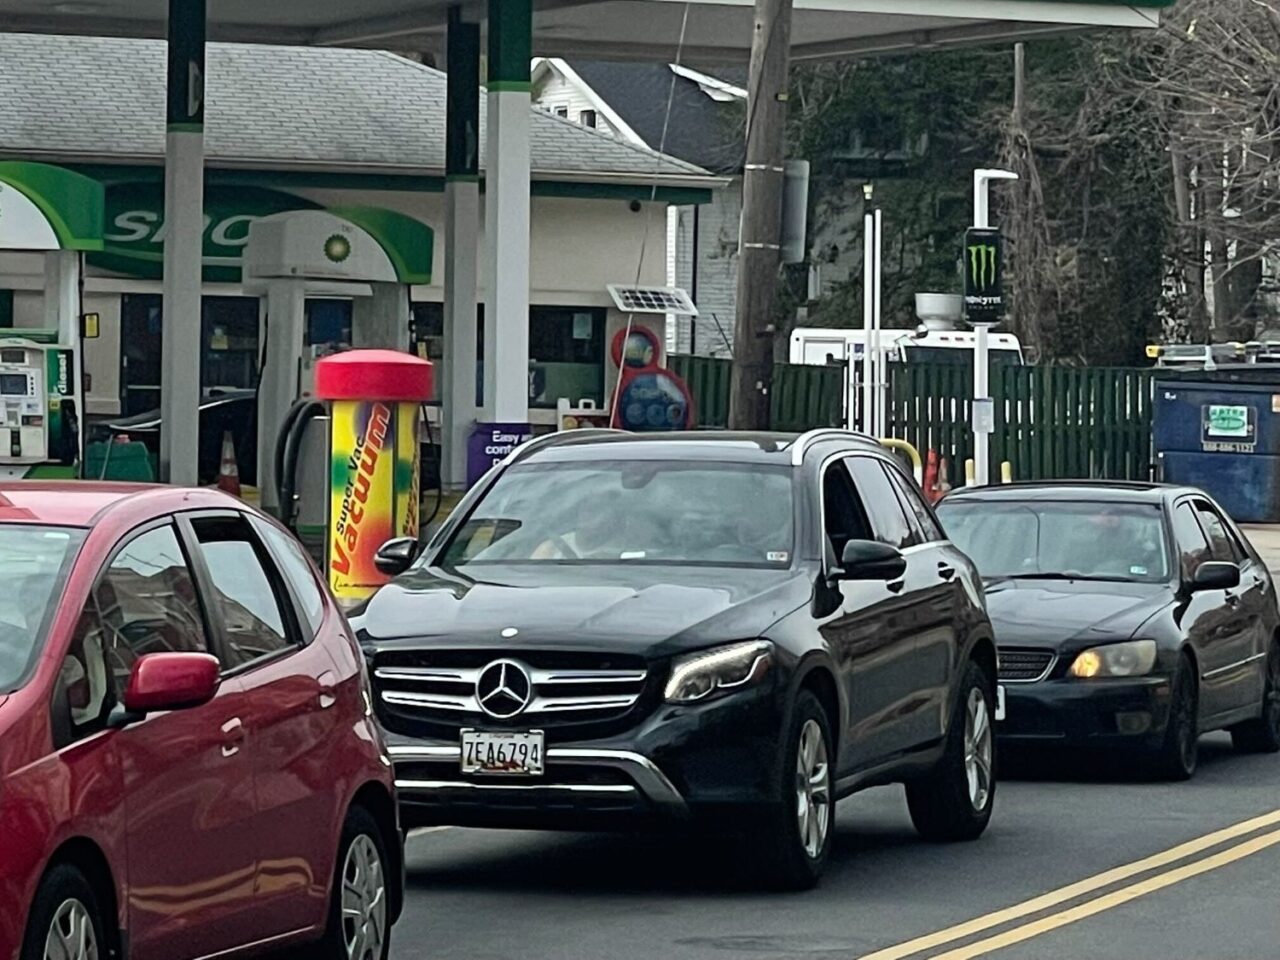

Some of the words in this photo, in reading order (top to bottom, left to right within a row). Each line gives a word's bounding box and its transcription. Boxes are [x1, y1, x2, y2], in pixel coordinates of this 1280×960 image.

[57, 353, 68, 394] diesel
[331, 403, 391, 576] Vacuum
[336, 481, 355, 536] Super
[348, 435, 365, 471] Vac
